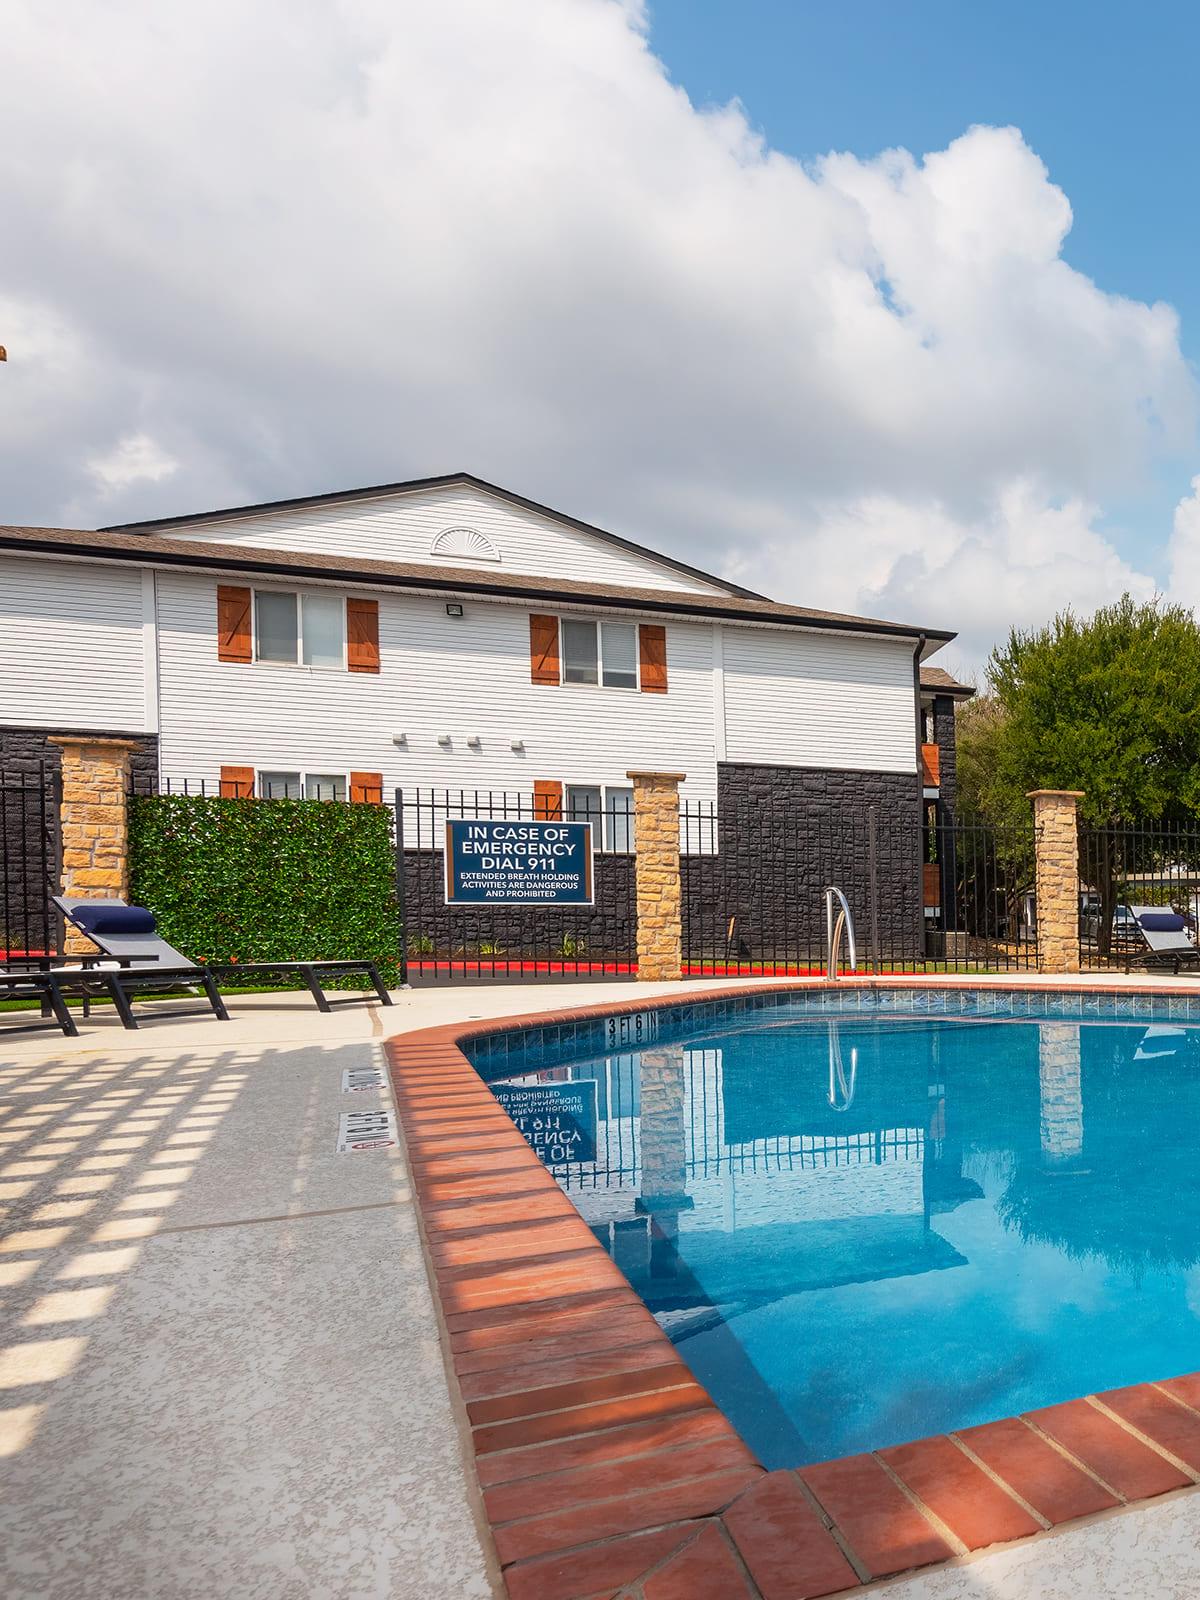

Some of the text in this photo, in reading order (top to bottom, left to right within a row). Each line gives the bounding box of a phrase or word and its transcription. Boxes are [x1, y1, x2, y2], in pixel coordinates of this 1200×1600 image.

[468, 826, 569, 841] IN CASE OF
[462, 841, 576, 856] EMERGENCY
[481, 857, 556, 871] DIAL 911
[460, 872, 506, 880] EXTENDED
[541, 873, 579, 881] HOLDING
[462, 881, 507, 889] ACTIVITIES
[506, 890, 557, 898] PROHIBITED
[608, 1011, 657, 1034] 3 FT 6 IN
